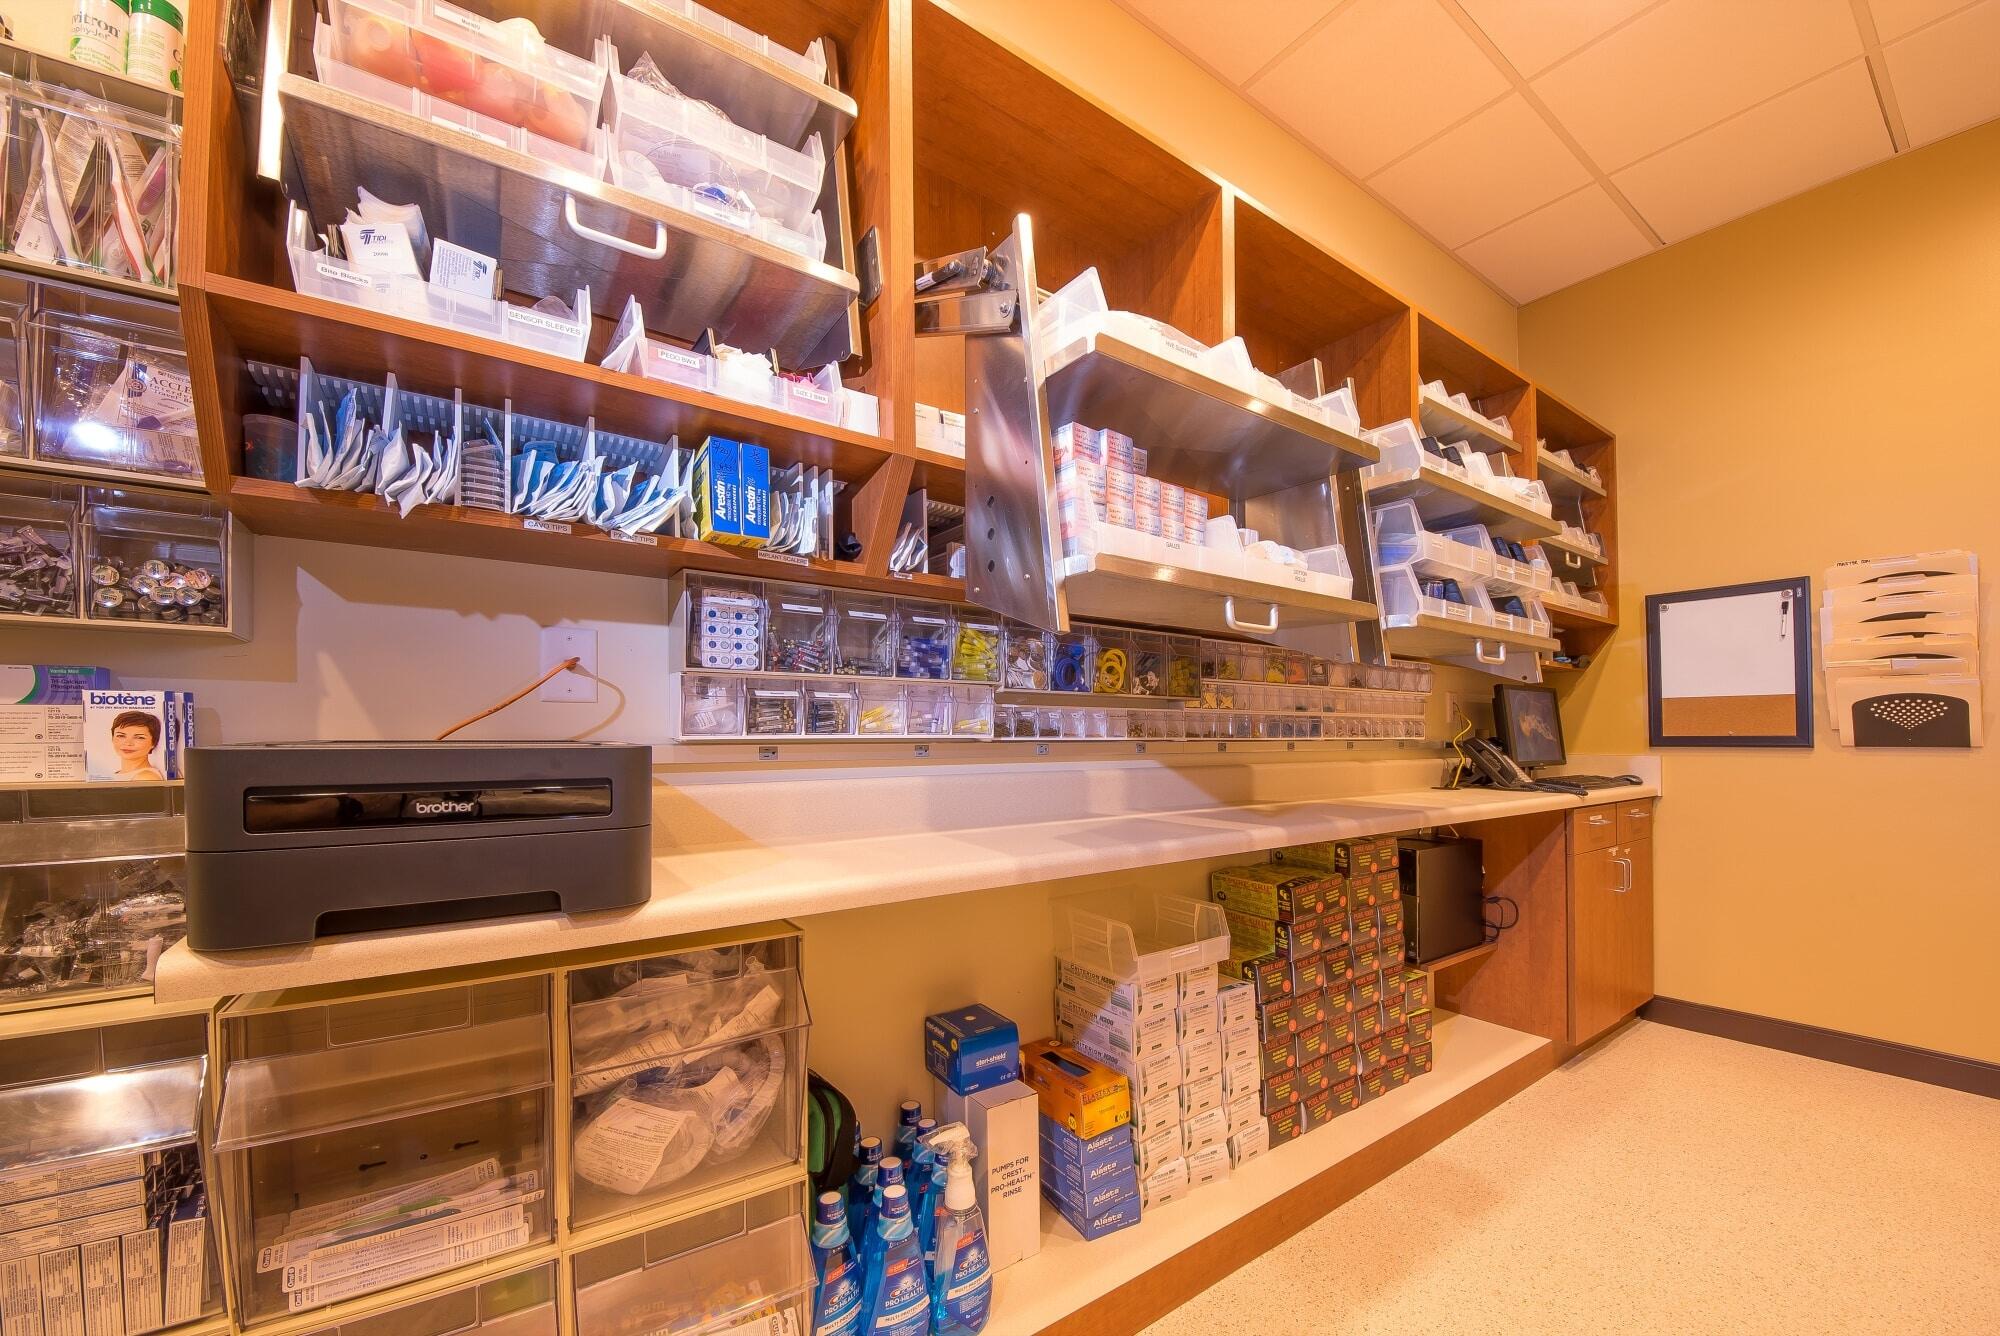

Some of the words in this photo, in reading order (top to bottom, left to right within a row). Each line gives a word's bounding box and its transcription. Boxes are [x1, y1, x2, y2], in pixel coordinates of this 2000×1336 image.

[509, 310, 544, 324] SENSOR
[545, 320, 581, 336] SLEEVES
[149, 376, 192, 394] ACCLE
[714, 480, 726, 520] Arestin
[745, 485, 756, 525] Arestin
[552, 524, 568, 532] TIPS
[640, 536, 655, 544] TIPS
[90, 692, 156, 705] biotène
[416, 801, 475, 814] brother
[992, 1161, 1015, 1175] PUMPS
[1015, 1156, 1029, 1166] FOR
